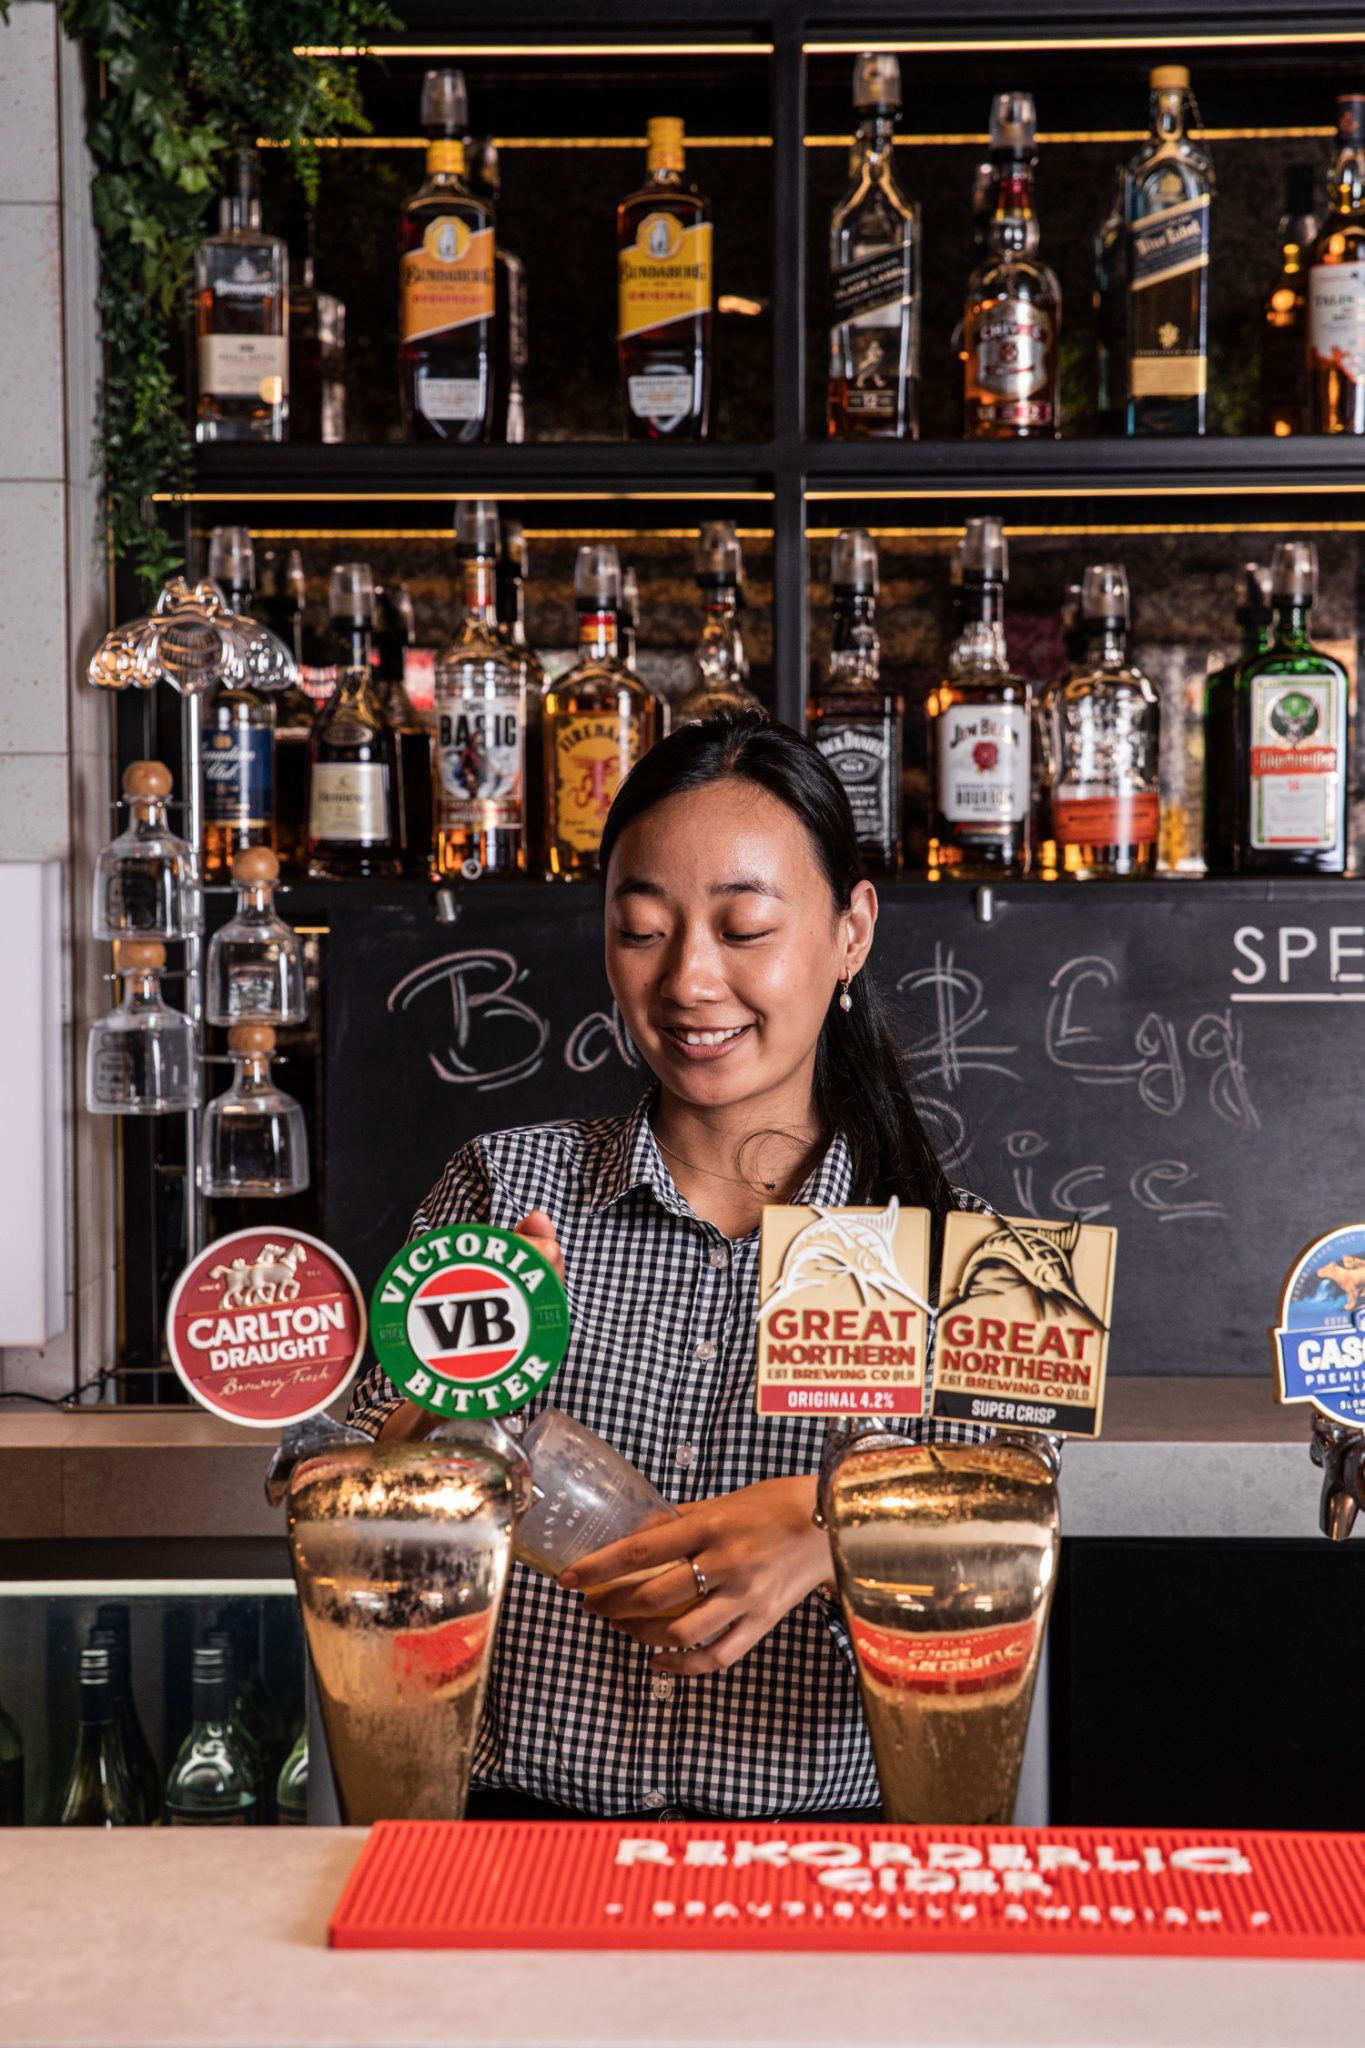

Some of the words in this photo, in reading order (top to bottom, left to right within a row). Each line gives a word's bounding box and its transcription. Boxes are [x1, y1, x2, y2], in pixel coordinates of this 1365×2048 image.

[559, 724, 634, 752] FIREBAL
[387, 949, 640, 1092] Ba
[379, 1232, 546, 1305] VICTORIA
[187, 1302, 345, 1350] CARLTON
[415, 1296, 516, 1351] VB
[768, 1308, 917, 1342] GREAT
[944, 1314, 1095, 1361] GREAT
[209, 1334, 330, 1371] DRAUGHT
[767, 1343, 916, 1366] NORTHERN
[942, 1349, 1092, 1386] NORTHERN
[1297, 1336, 1365, 1372] CAS
[404, 1354, 551, 1412] BITTER
[792, 1367, 867, 1381] BREWING
[965, 1374, 1041, 1396] BREWING
[788, 1391, 858, 1408] ORIGINAL
[860, 1391, 895, 1409] 4.2%
[971, 1399, 1015, 1420] SUPER
[1016, 1403, 1057, 1424] CRISP
[565, 1484, 596, 1528] HOTL
[615, 1838, 1252, 1875] REKORDERLIG
[817, 1867, 1052, 1898] CIDER
